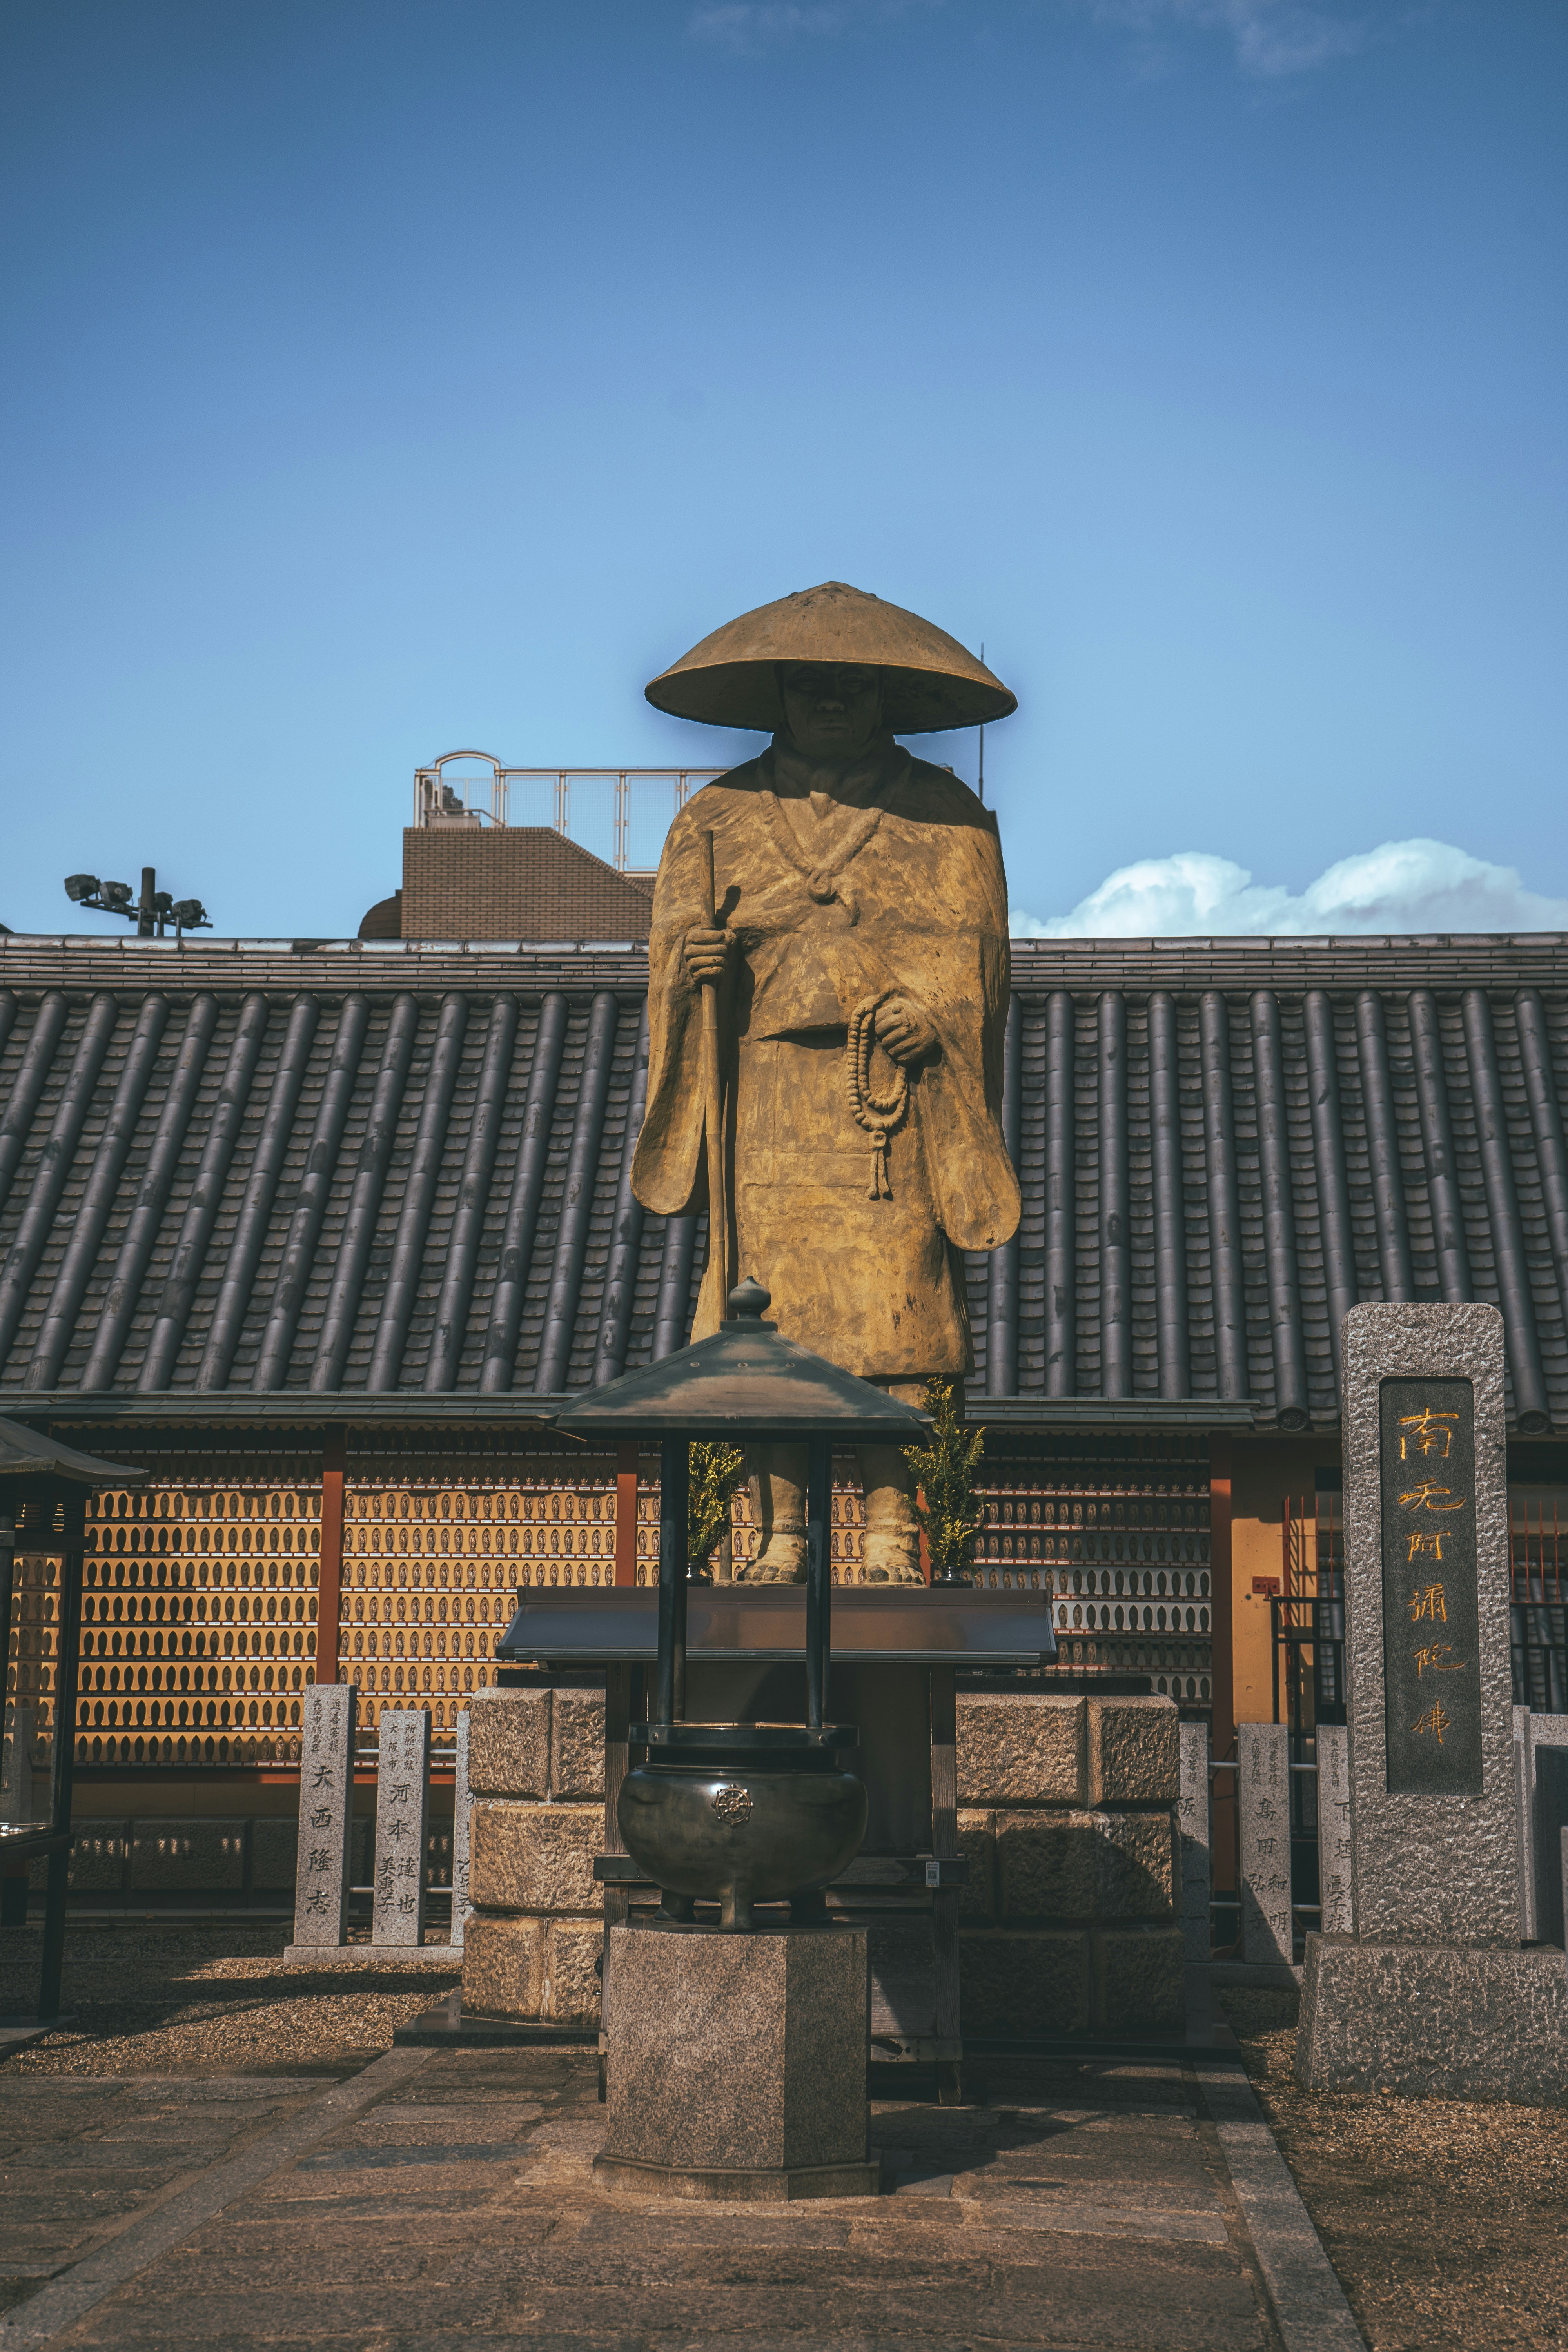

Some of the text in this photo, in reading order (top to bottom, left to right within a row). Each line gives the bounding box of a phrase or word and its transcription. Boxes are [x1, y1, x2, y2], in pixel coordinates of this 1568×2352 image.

[387, 1723, 398, 1770] 大阪市
[306, 1765, 335, 1915] 大西隆志
[387, 1784, 412, 1842] 河本
